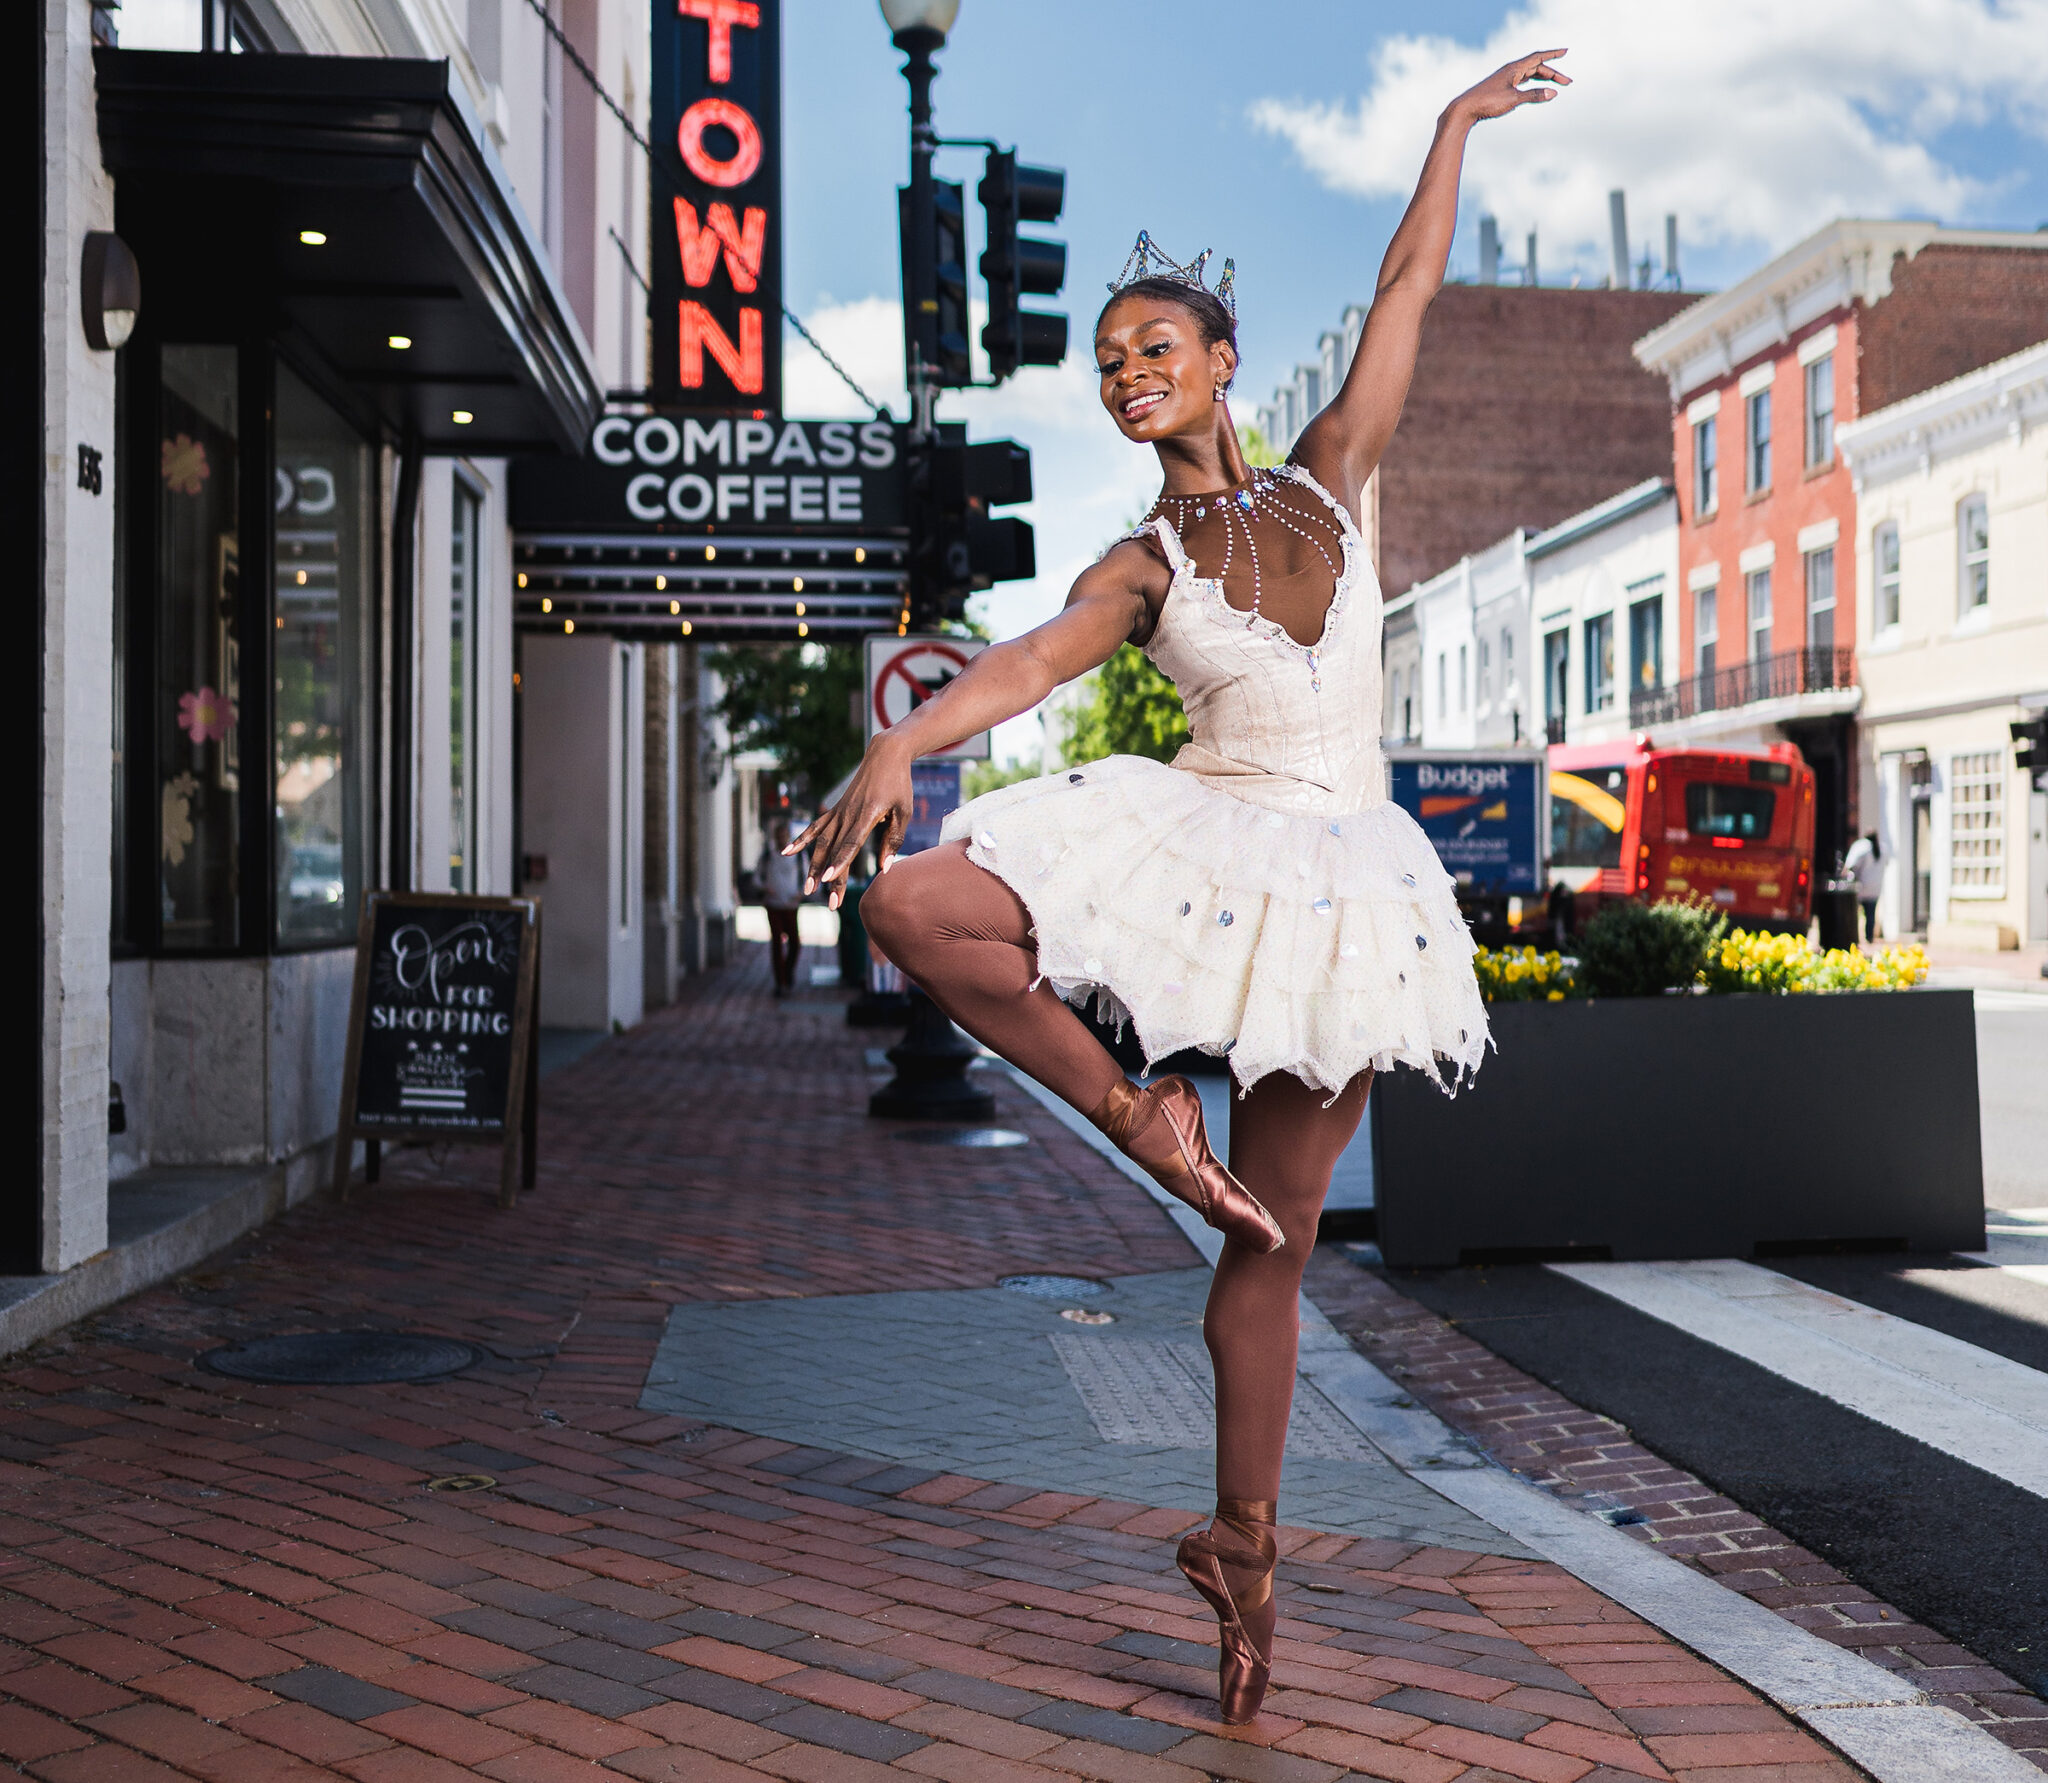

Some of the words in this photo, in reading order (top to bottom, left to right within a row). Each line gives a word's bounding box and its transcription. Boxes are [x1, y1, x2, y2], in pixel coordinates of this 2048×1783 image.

[674, 0, 767, 394] TOWN
[592, 418, 896, 469] COMPASS
[626, 474, 863, 521] COFFEE
[1418, 764, 1509, 795] Budget
[391, 921, 509, 1003] Open
[371, 1004, 510, 1034] SHOPPING
[447, 985, 494, 1006] FOR
